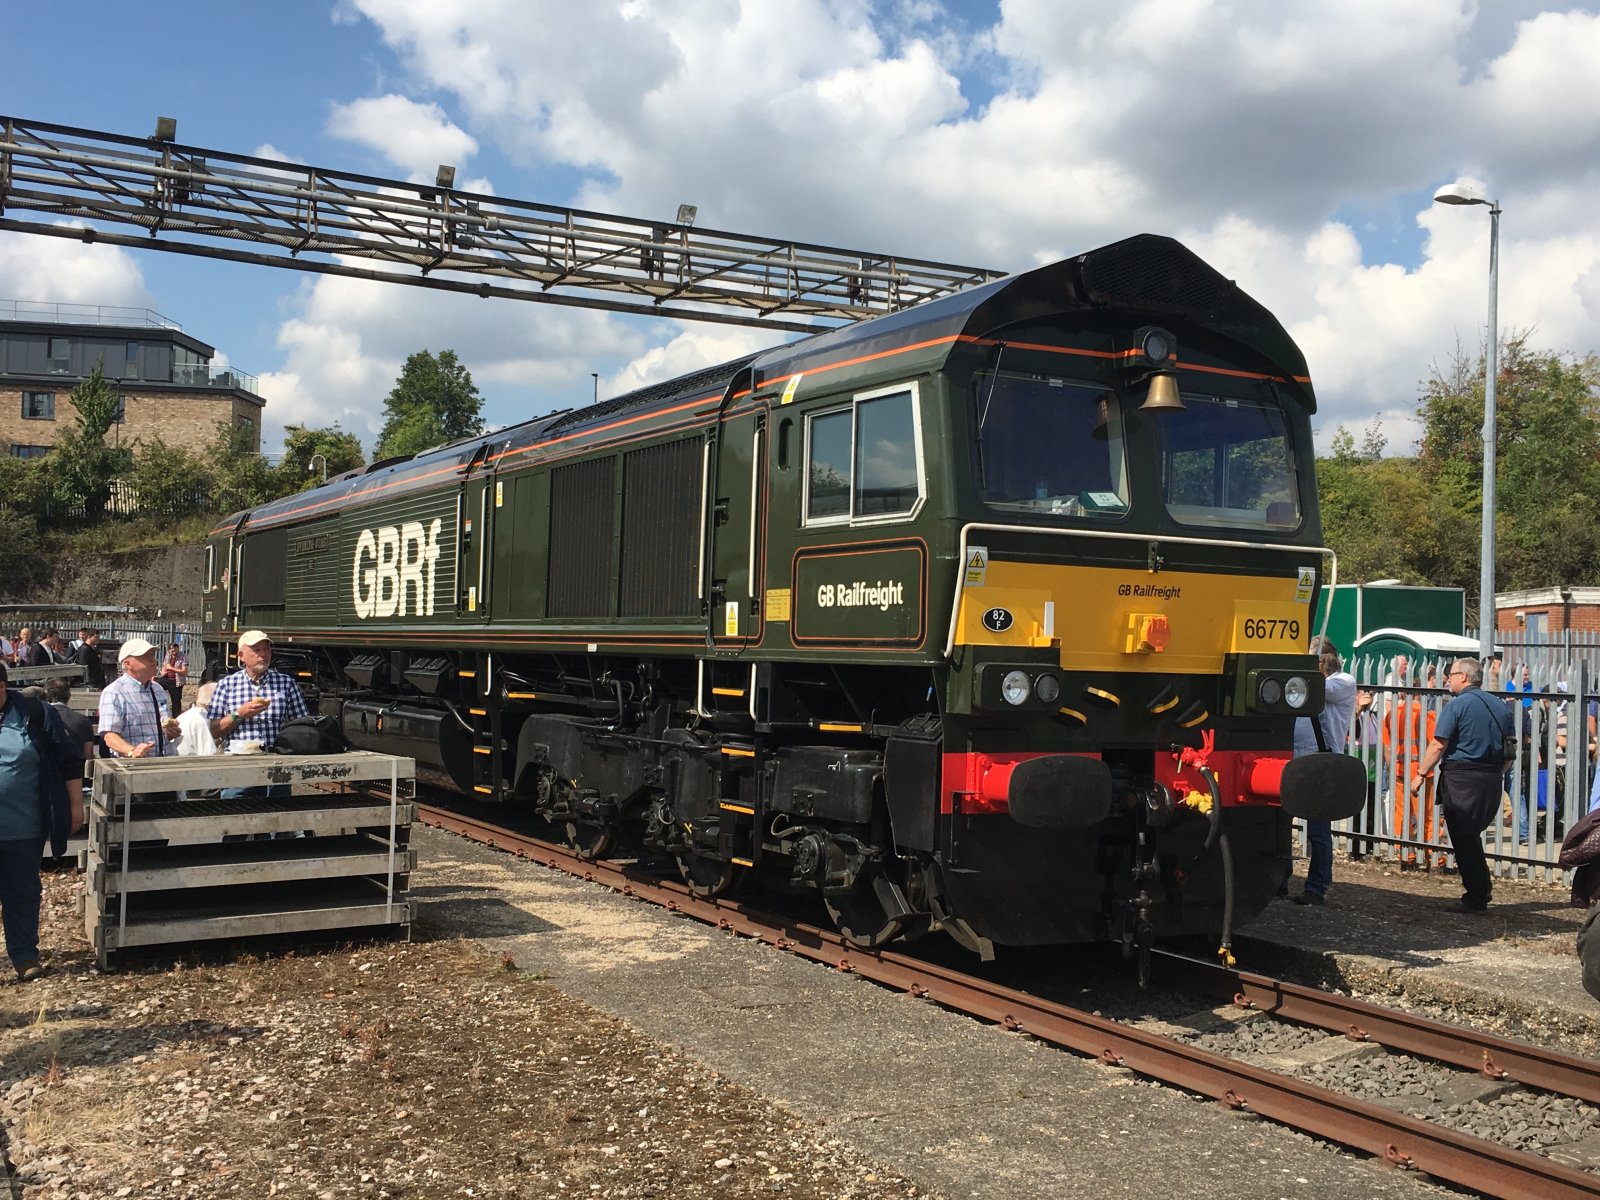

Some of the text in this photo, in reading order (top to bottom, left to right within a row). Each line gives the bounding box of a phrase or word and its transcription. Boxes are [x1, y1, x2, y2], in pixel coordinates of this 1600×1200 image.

[353, 518, 441, 619] GBRf
[818, 584, 834, 607] GB
[837, 580, 903, 611] Railfreight
[1118, 584, 1180, 600] GB Railfreight
[992, 610, 1005, 620] 82
[996, 621, 1001, 630] F
[1244, 618, 1300, 640] 66779
